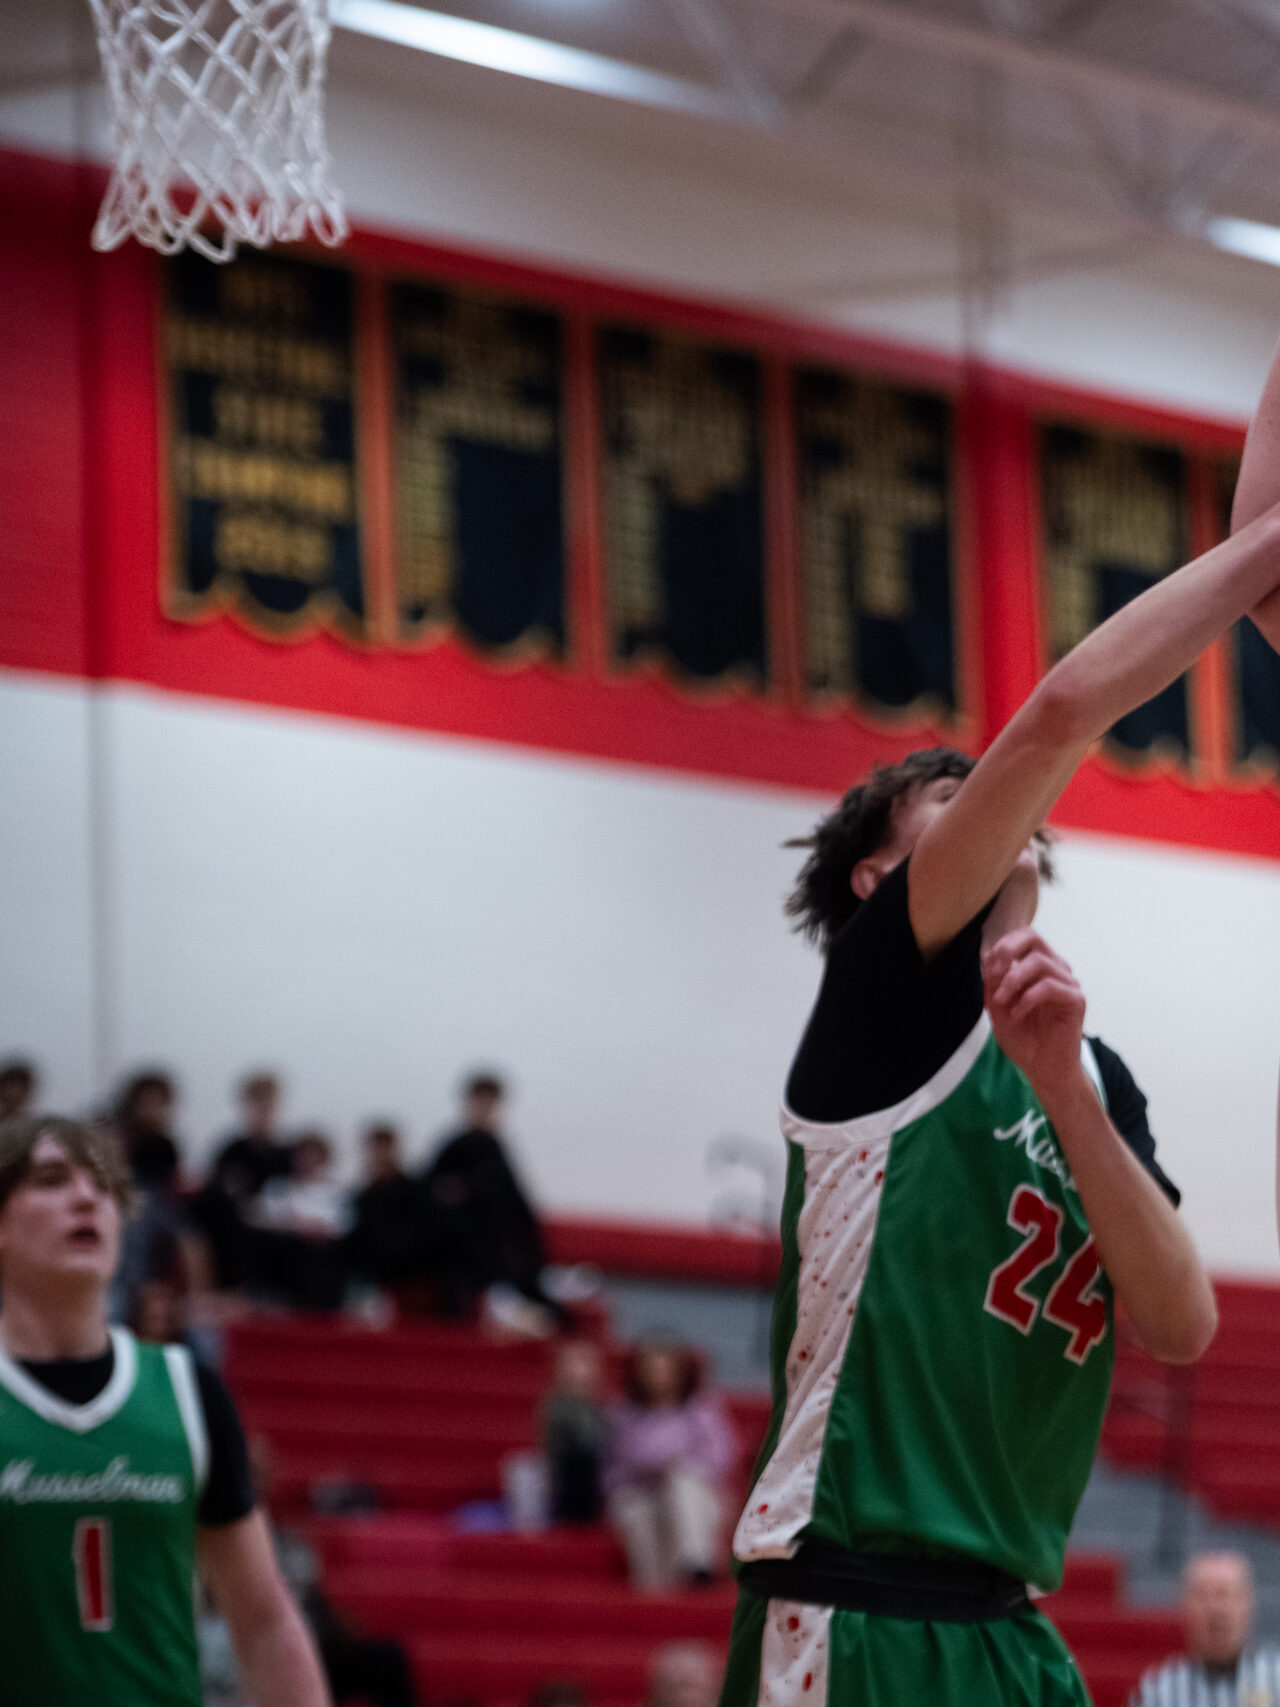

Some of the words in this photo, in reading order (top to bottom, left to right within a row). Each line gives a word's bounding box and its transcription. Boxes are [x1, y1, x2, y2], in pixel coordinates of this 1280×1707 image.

[983, 1183, 1108, 1366] 24
[0, 1455, 184, 1504] Musselman
[73, 1517, 114, 1633] 1
